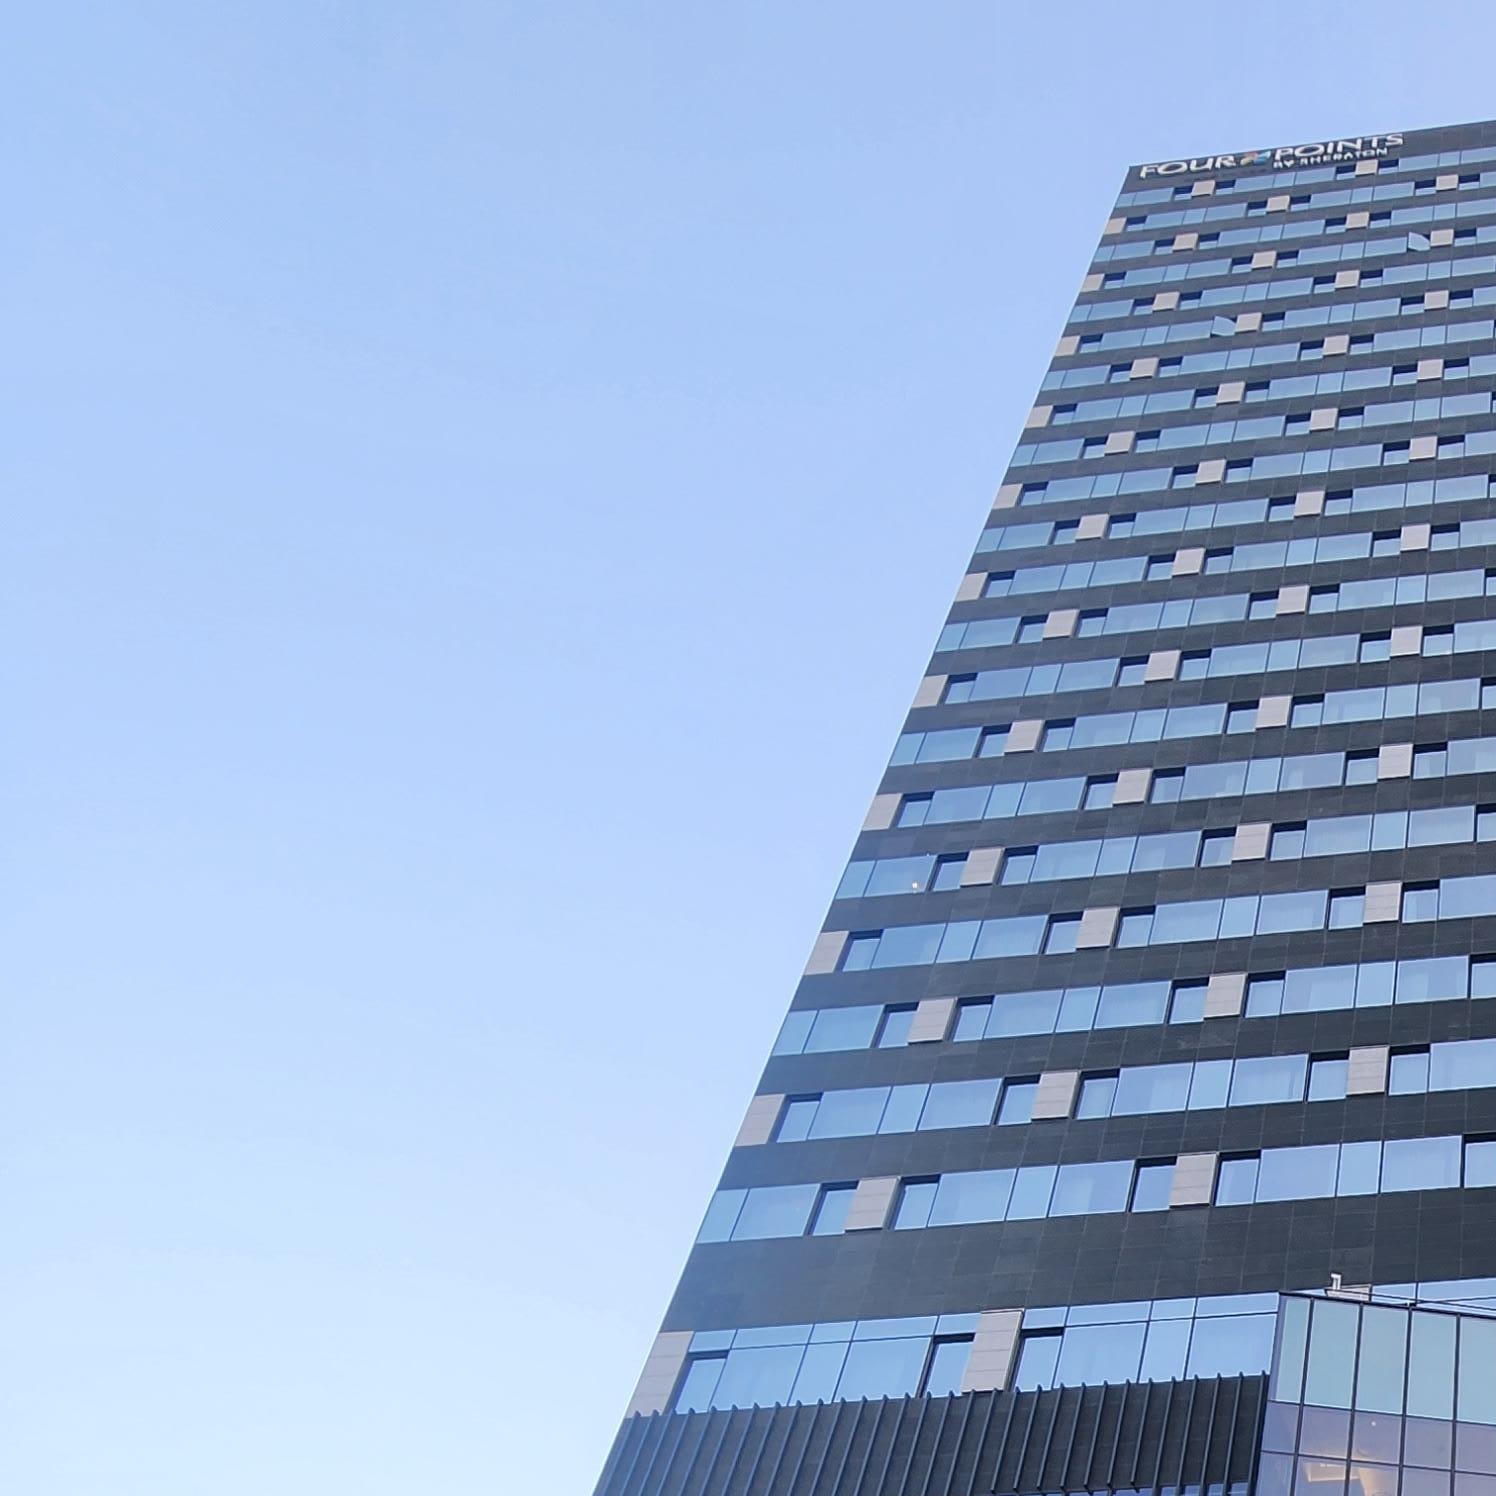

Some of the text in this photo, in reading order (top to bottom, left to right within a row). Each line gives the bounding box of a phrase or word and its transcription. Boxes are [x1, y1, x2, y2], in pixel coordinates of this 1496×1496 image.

[1140, 133, 1404, 178] FOUR POINTS
[1273, 160, 1295, 169] BY
